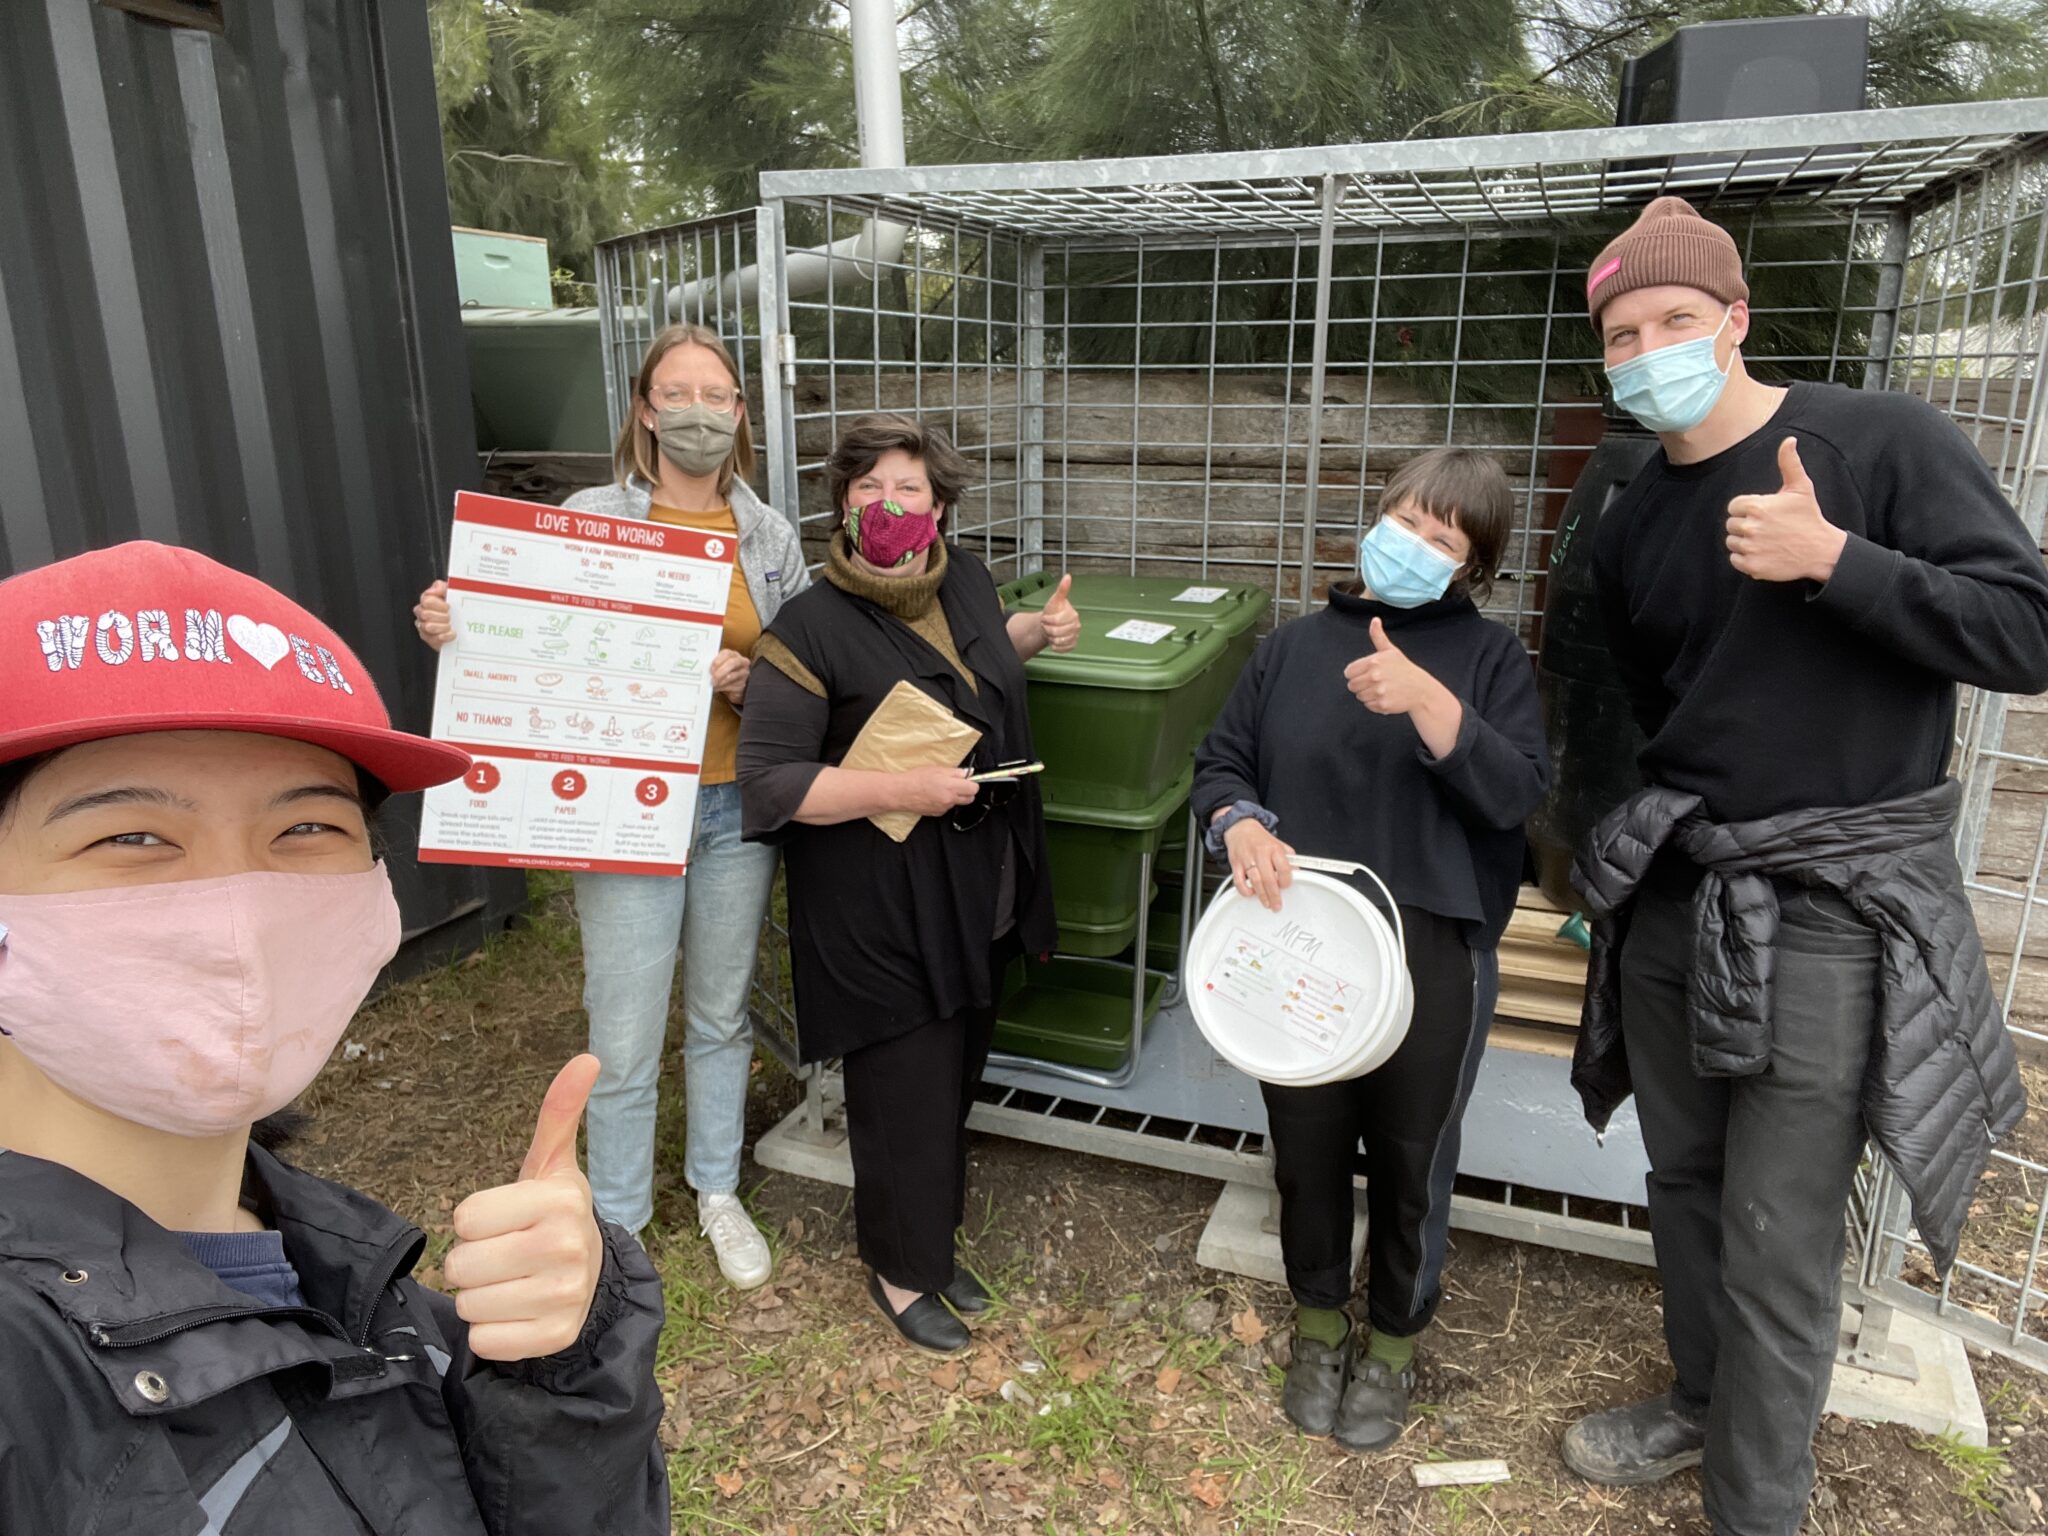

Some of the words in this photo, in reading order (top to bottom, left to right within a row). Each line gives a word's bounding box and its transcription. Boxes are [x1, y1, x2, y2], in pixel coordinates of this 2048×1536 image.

[534, 511, 569, 533] LOVE
[575, 518, 610, 540] YOUR
[616, 525, 665, 548] WORMS
[667, 571, 690, 581] NEEDED
[465, 621, 486, 634] YES
[487, 624, 524, 639] PLEASE!
[36, 608, 233, 672] WORM
[456, 711, 469, 722] NO
[471, 713, 512, 727] THANKS!
[476, 770, 487, 785] 1
[562, 777, 575, 792] 2
[644, 784, 658, 801] 3
[469, 799, 487, 808] FOOD
[554, 805, 576, 815] PAPER
[1273, 920, 1324, 962] MFM
